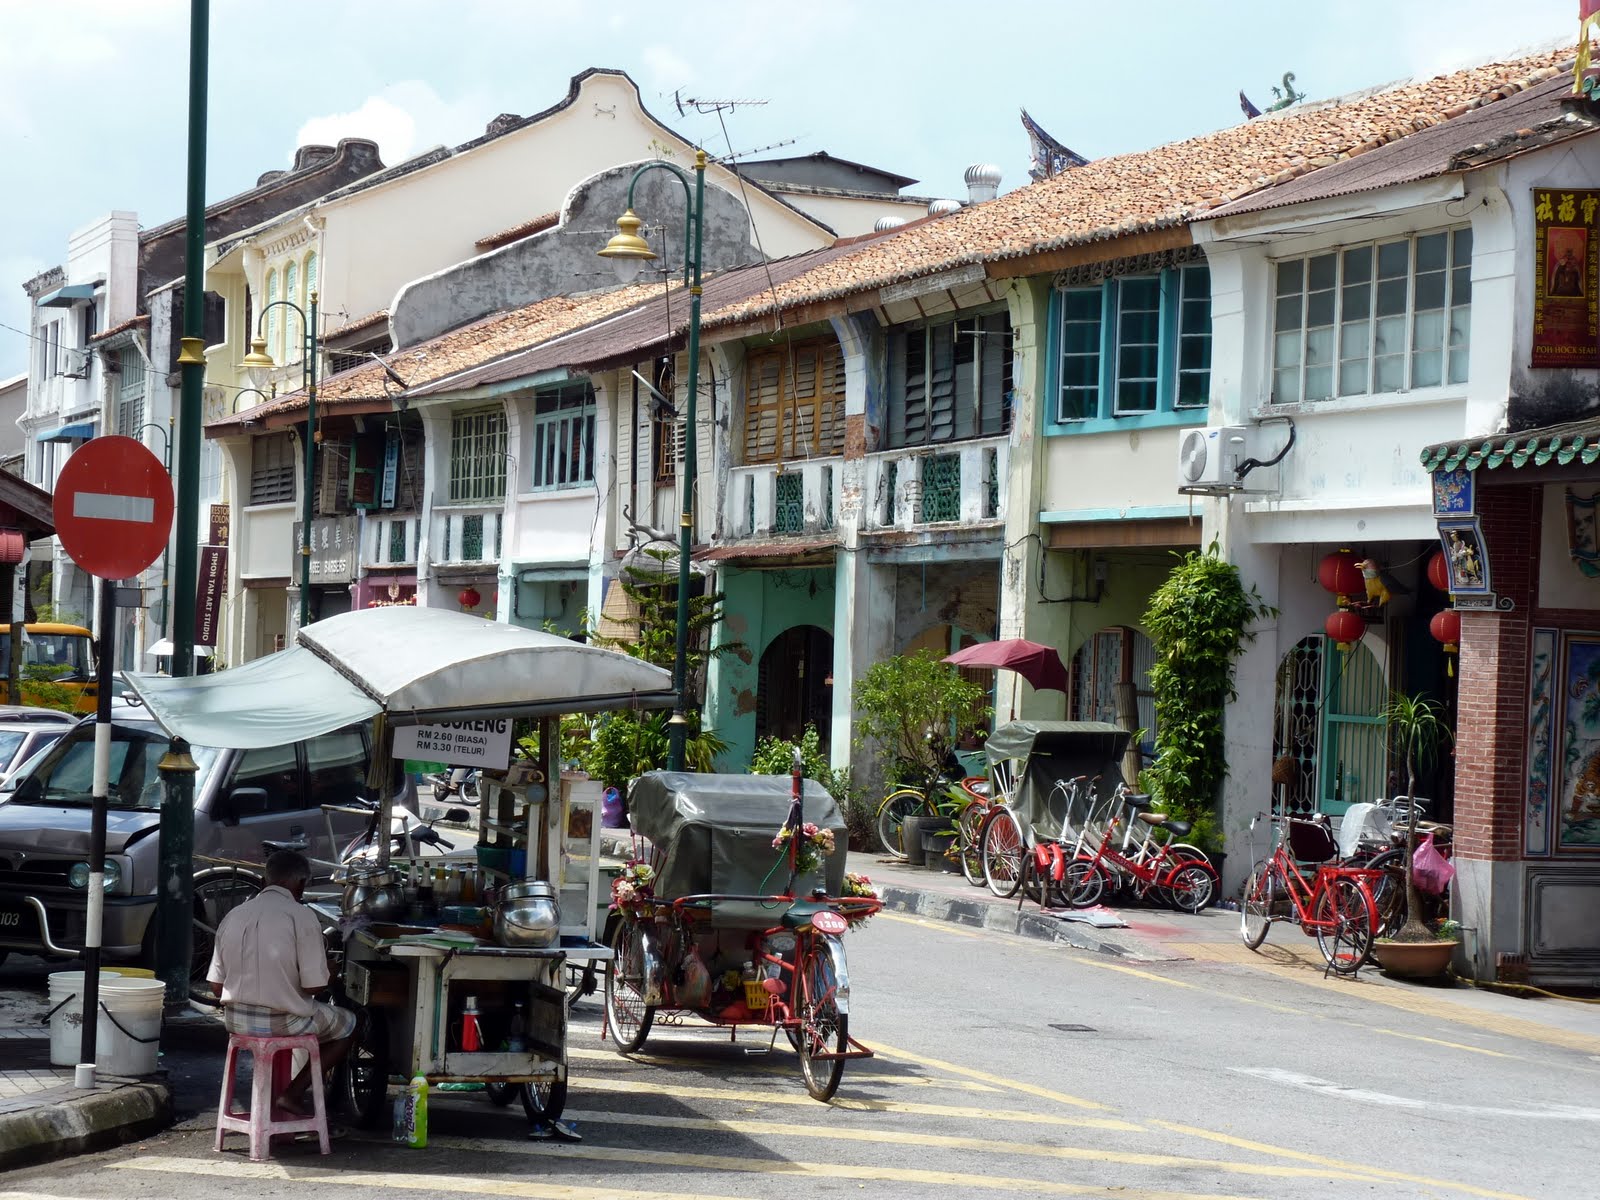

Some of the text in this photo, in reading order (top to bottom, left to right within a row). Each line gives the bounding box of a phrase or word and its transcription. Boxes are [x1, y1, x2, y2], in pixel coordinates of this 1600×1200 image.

[1536, 345, 1597, 355] POH HOCK SEAH
[202, 552, 219, 642] SIMON TAN ART STUDIO
[417, 729, 488, 746] RM 2.60 (BIASA)
[416, 740, 486, 757] RM 3.30 (TELUR)
[0, 911, 20, 926] 103
